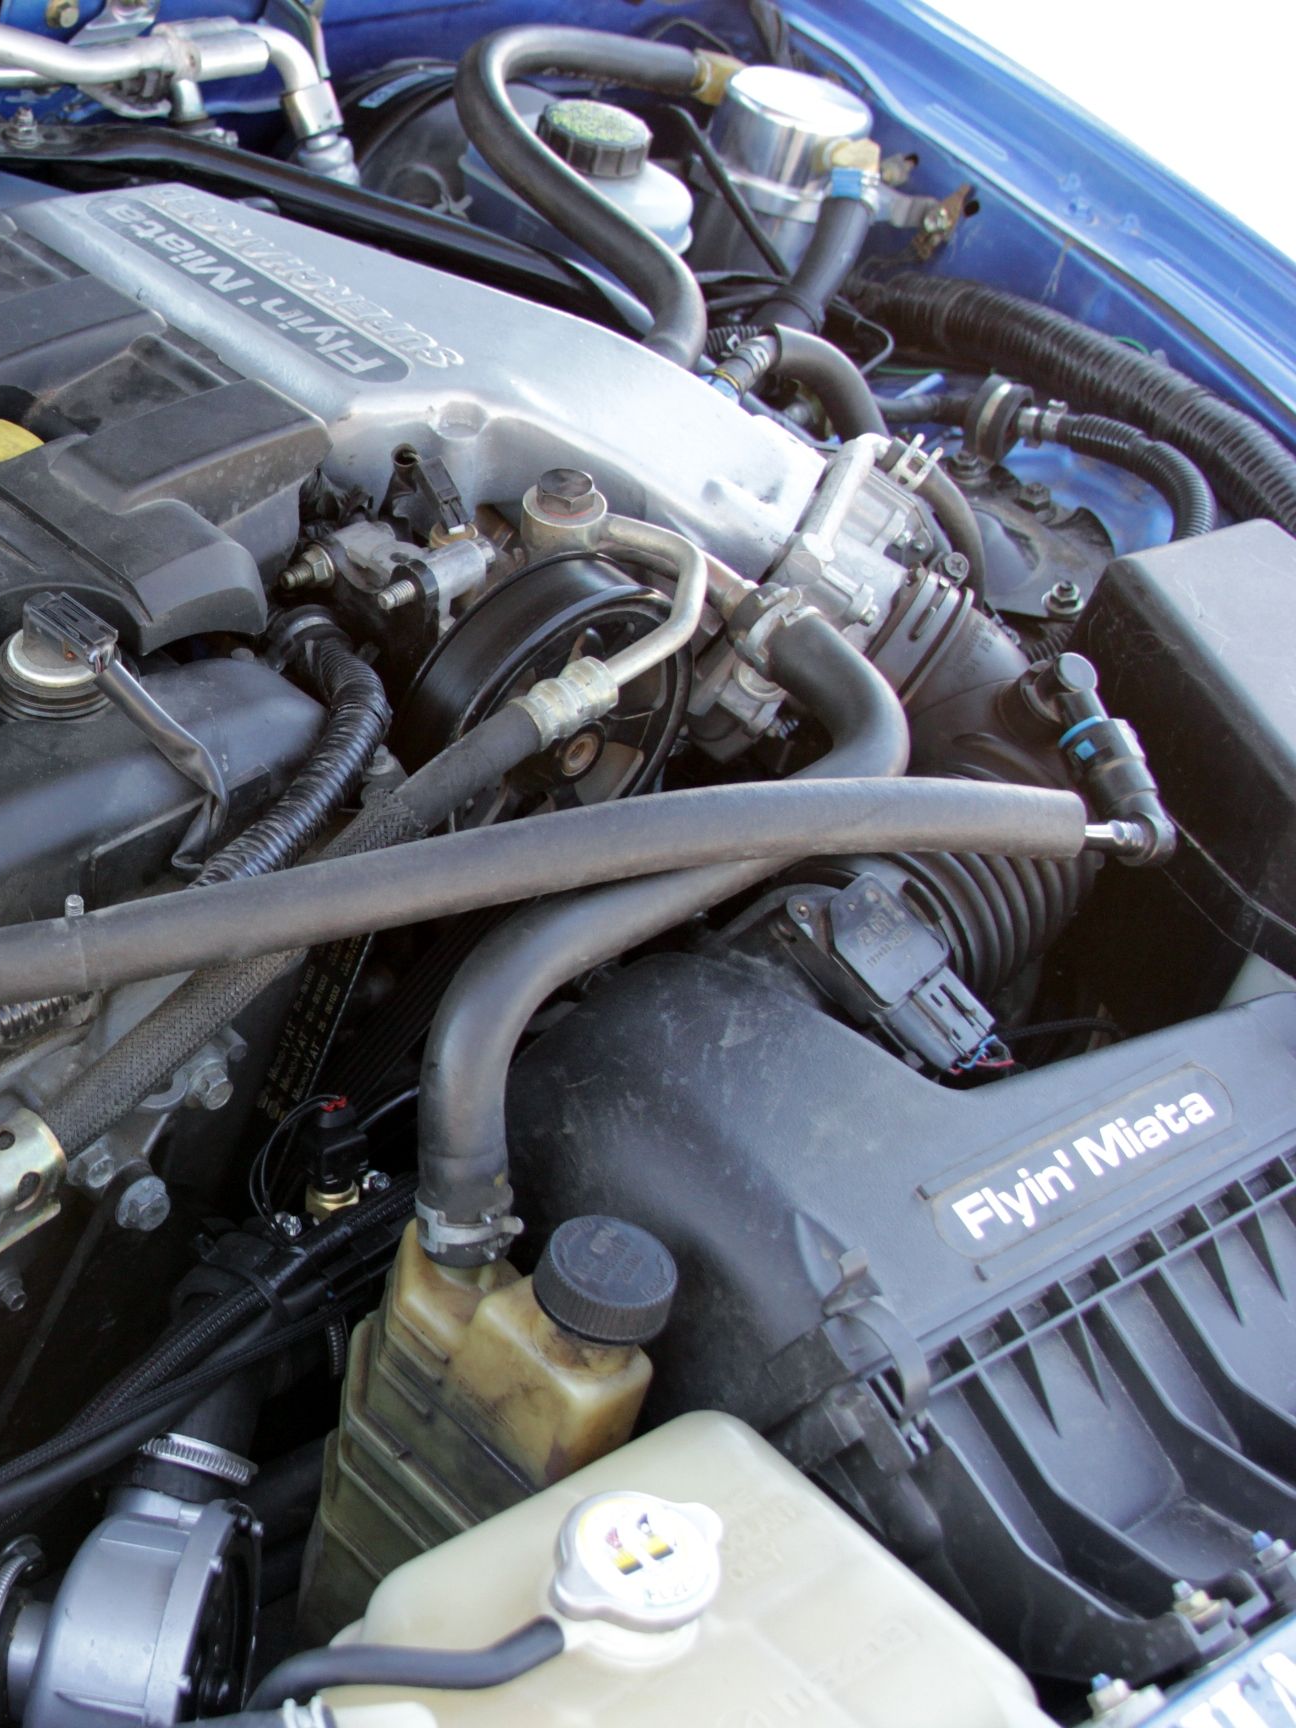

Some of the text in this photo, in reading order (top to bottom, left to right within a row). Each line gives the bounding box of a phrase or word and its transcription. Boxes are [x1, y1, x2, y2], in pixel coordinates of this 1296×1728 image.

[105, 203, 385, 375] Flyin' Miata
[951, 1091, 1216, 1241] Flyin' Miata
